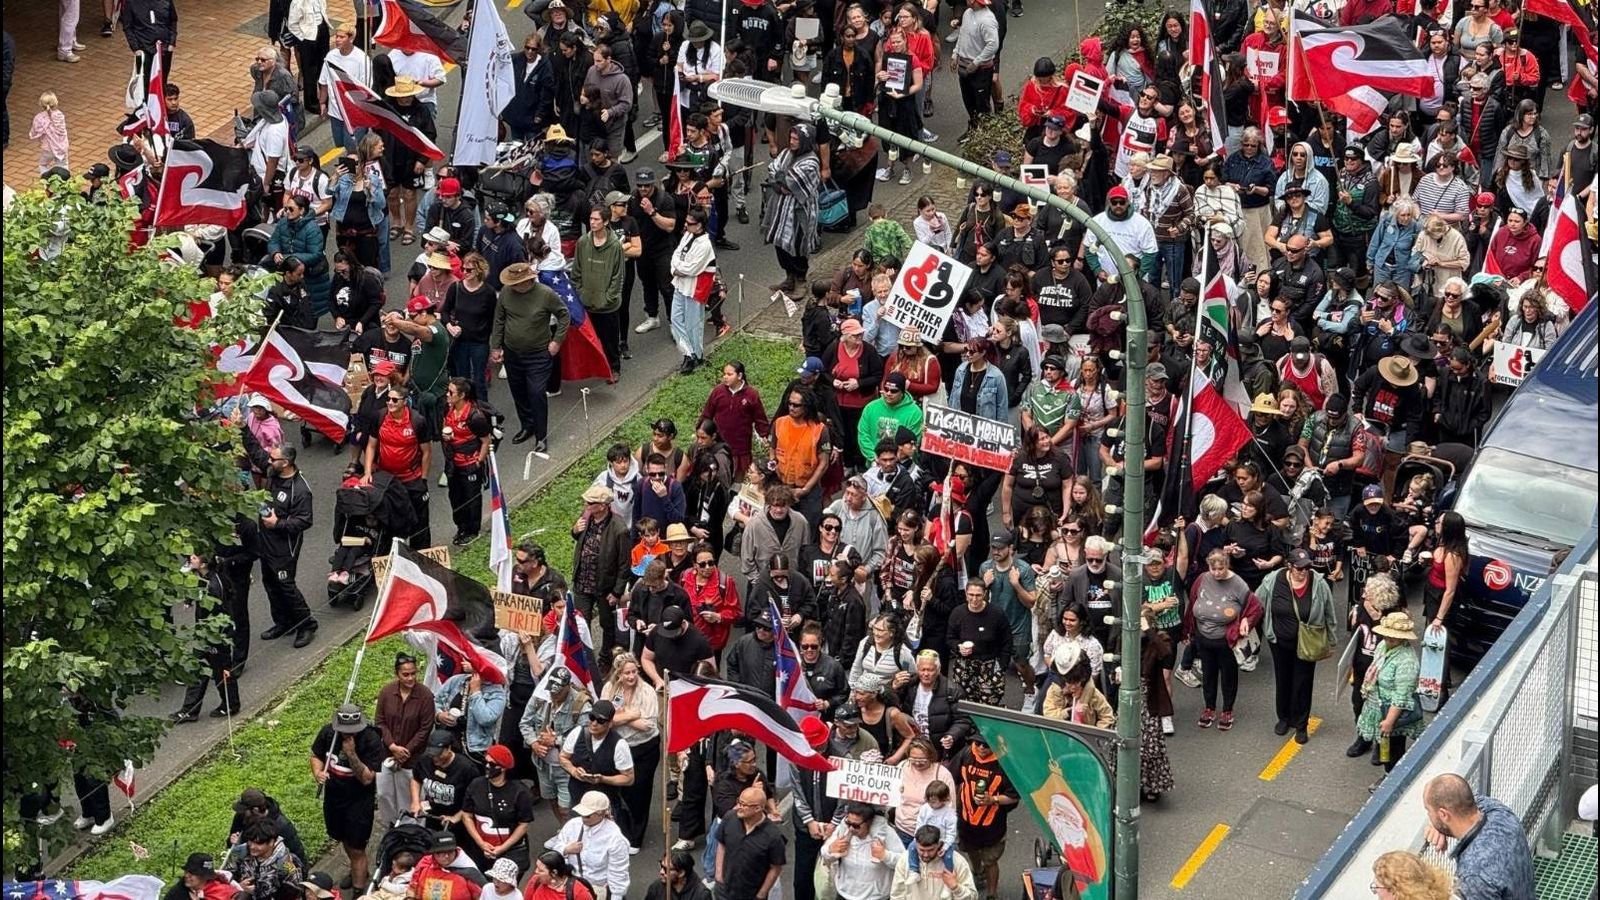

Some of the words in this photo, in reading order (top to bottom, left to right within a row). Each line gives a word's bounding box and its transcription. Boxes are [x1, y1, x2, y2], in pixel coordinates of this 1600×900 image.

[887, 305, 895, 317] FOR
[892, 294, 943, 329] TOGETHER
[895, 309, 908, 324] TE
[909, 316, 938, 339] TIRITI
[926, 406, 974, 437] TAGATA
[975, 420, 1015, 447] MOANA
[507, 609, 540, 632] TIRITI
[846, 773, 865, 786] FOR
[867, 777, 891, 792] OUR
[864, 763, 875, 776] TE
[876, 764, 902, 780] TIRITI
[838, 783, 890, 806] Future
